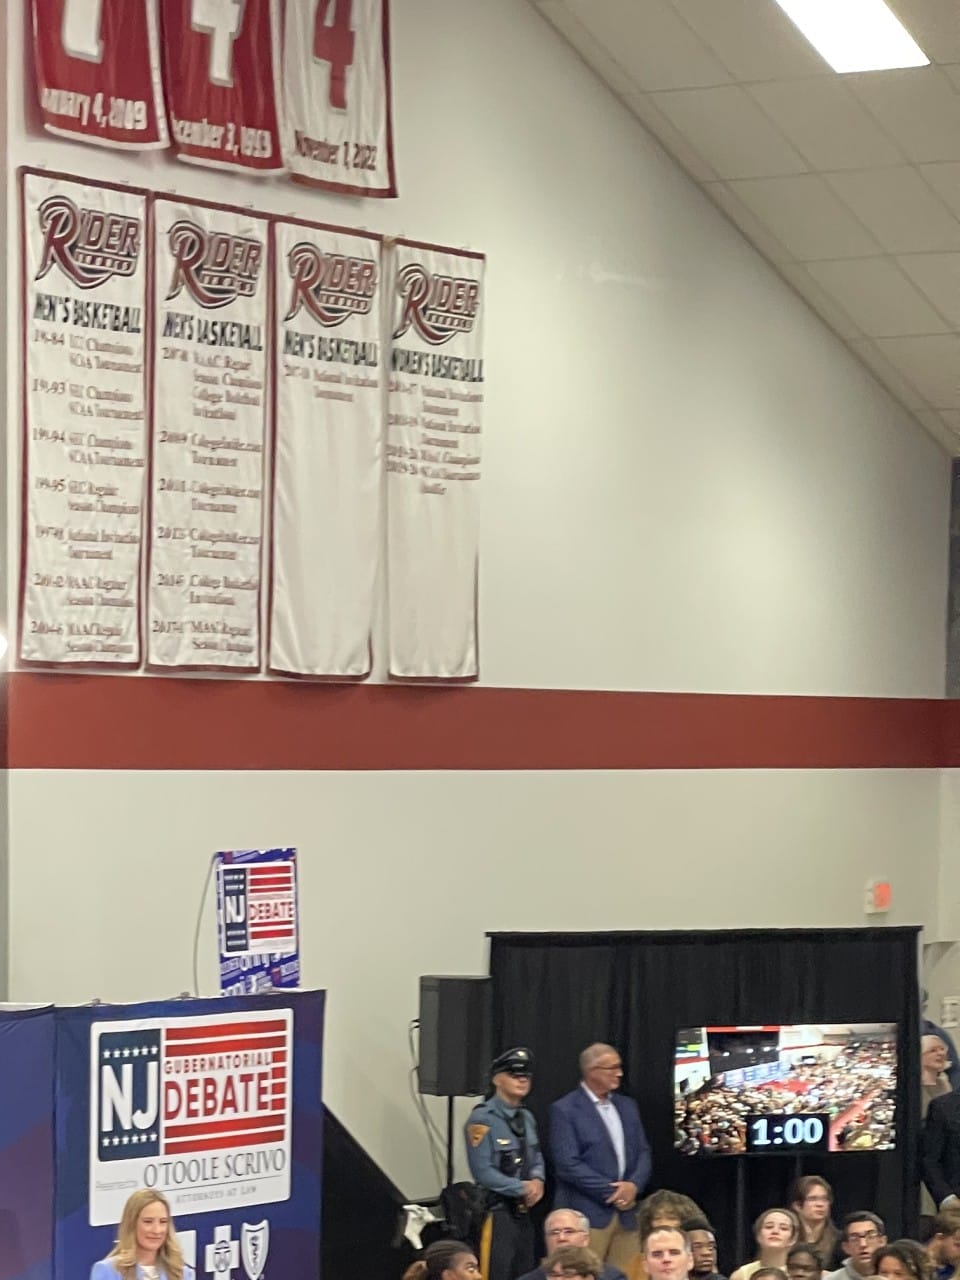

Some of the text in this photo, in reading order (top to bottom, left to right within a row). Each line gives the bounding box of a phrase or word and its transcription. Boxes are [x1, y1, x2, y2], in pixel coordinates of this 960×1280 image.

[35, 195, 140, 290] RIDER
[165, 220, 263, 310] RIDER
[283, 241, 378, 328] RIDER
[392, 263, 480, 346] RIDER
[73, 298, 142, 334] BASKETBALL
[225, 894, 246, 924] NJ
[249, 901, 294, 921] DEBATE
[164, 1051, 272, 1076] GUBERNATORIAL
[101, 1061, 159, 1133] NJ
[164, 1071, 272, 1121] DEBATE
[751, 1117, 824, 1146] 1:00
[143, 1157, 220, 1188] O'TOOLE
[223, 1148, 287, 1180] SCRIVO
